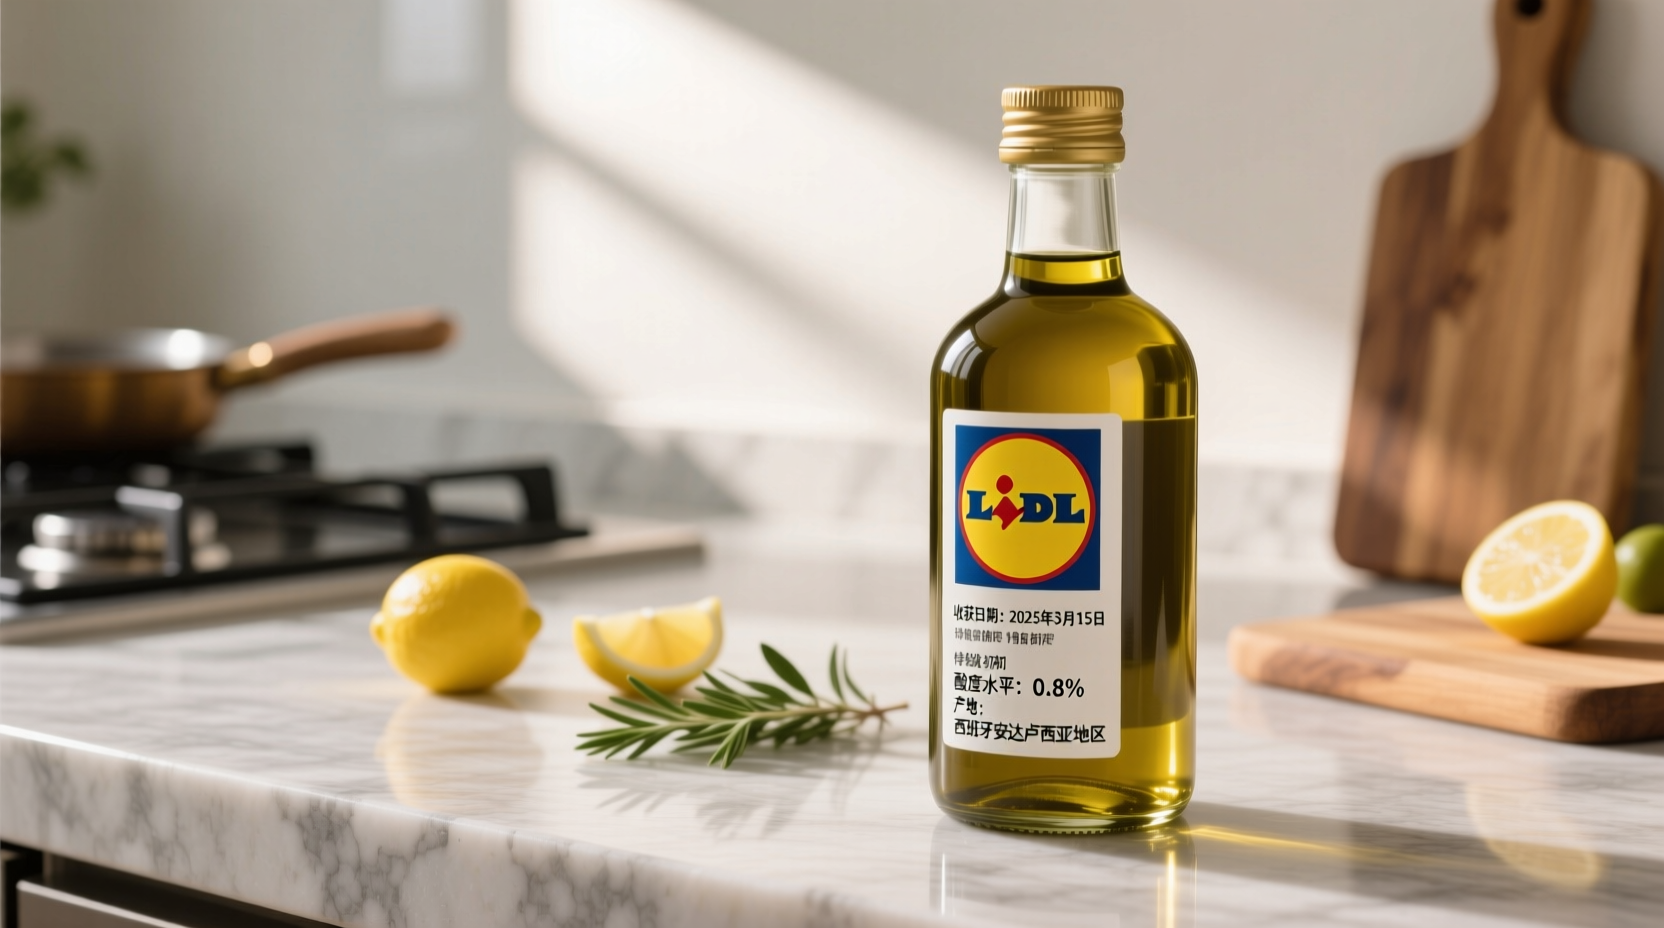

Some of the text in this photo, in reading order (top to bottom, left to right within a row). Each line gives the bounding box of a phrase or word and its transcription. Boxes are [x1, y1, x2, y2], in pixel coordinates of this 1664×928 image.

[1009, 609, 1105, 626] 2025年3月15日
[1032, 677, 1085, 698] 0.8%
[954, 718, 1106, 743] 西班牙安达卢西亚地区
